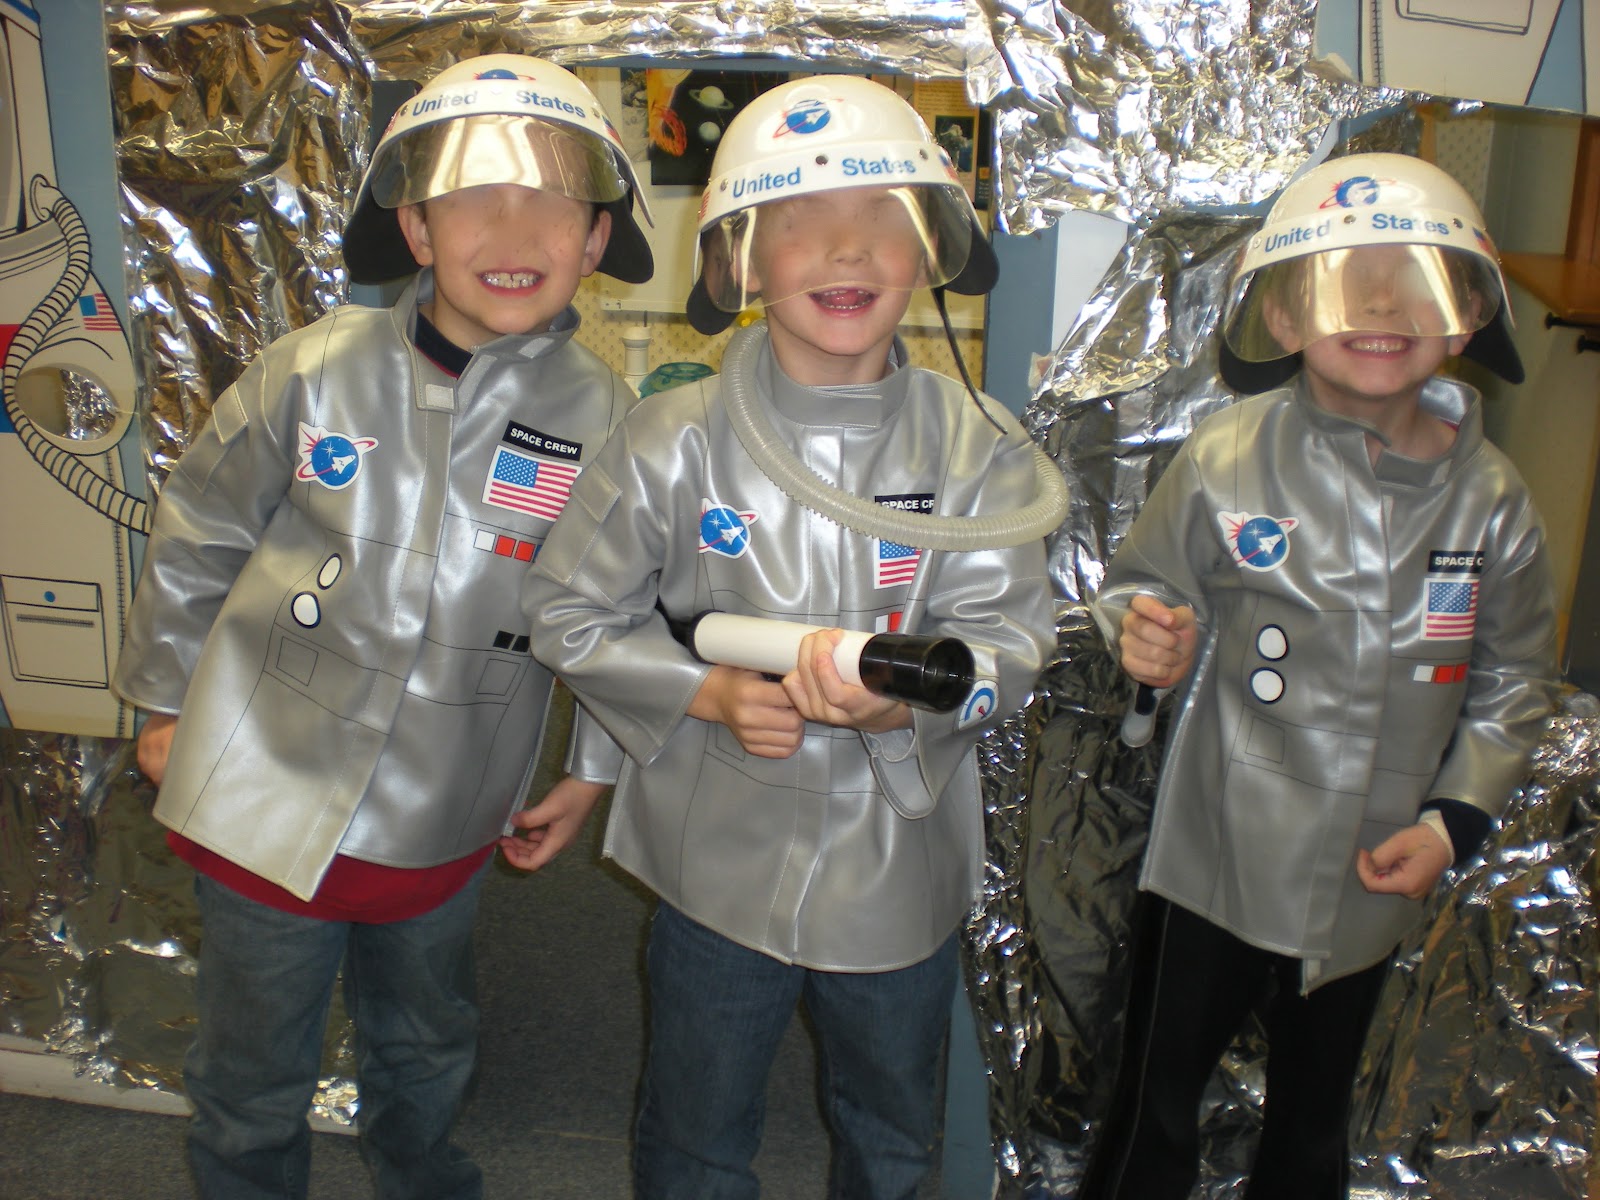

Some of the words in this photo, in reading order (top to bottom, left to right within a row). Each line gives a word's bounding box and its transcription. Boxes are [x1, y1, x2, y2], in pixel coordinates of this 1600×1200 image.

[412, 90, 478, 117] United
[516, 90, 586, 118] States
[732, 166, 801, 199] United
[842, 157, 916, 176] States
[1264, 219, 1331, 253] United
[1372, 213, 1450, 235] Staes
[510, 427, 543, 447] SPACE
[544, 440, 578, 455] CREW
[1434, 556, 1474, 567] SPACE
